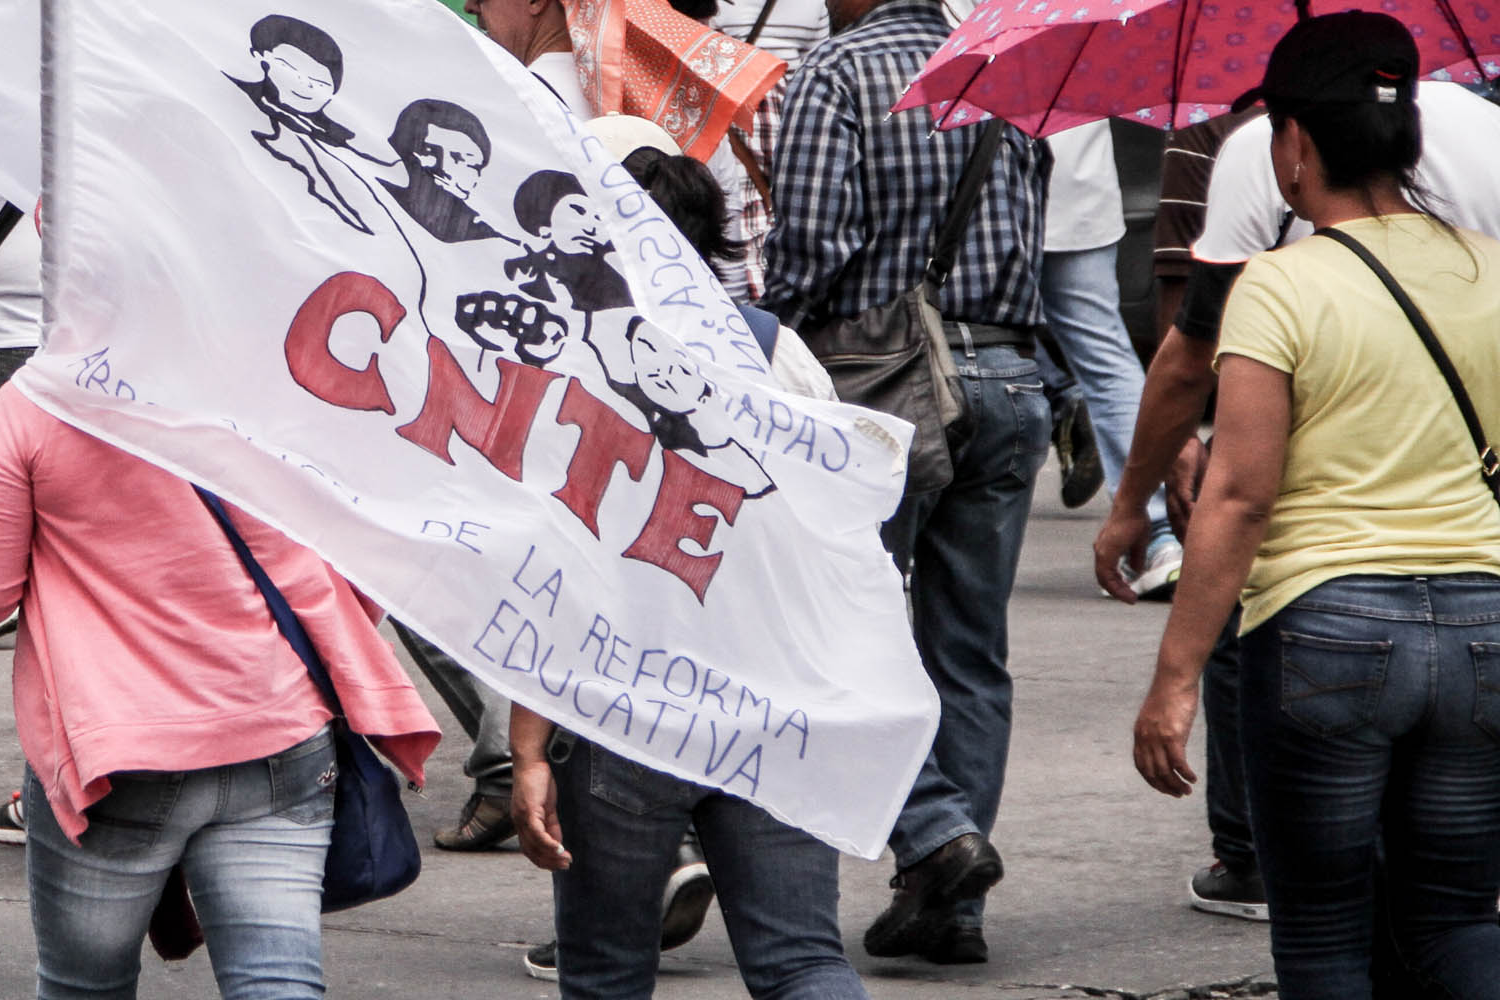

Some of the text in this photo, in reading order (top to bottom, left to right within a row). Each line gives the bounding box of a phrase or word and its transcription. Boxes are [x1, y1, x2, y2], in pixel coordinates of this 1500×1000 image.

[283, 270, 746, 607] CNTE
[420, 519, 810, 760] DE LA REFORMA
[473, 598, 764, 798] EDUCATIVA
